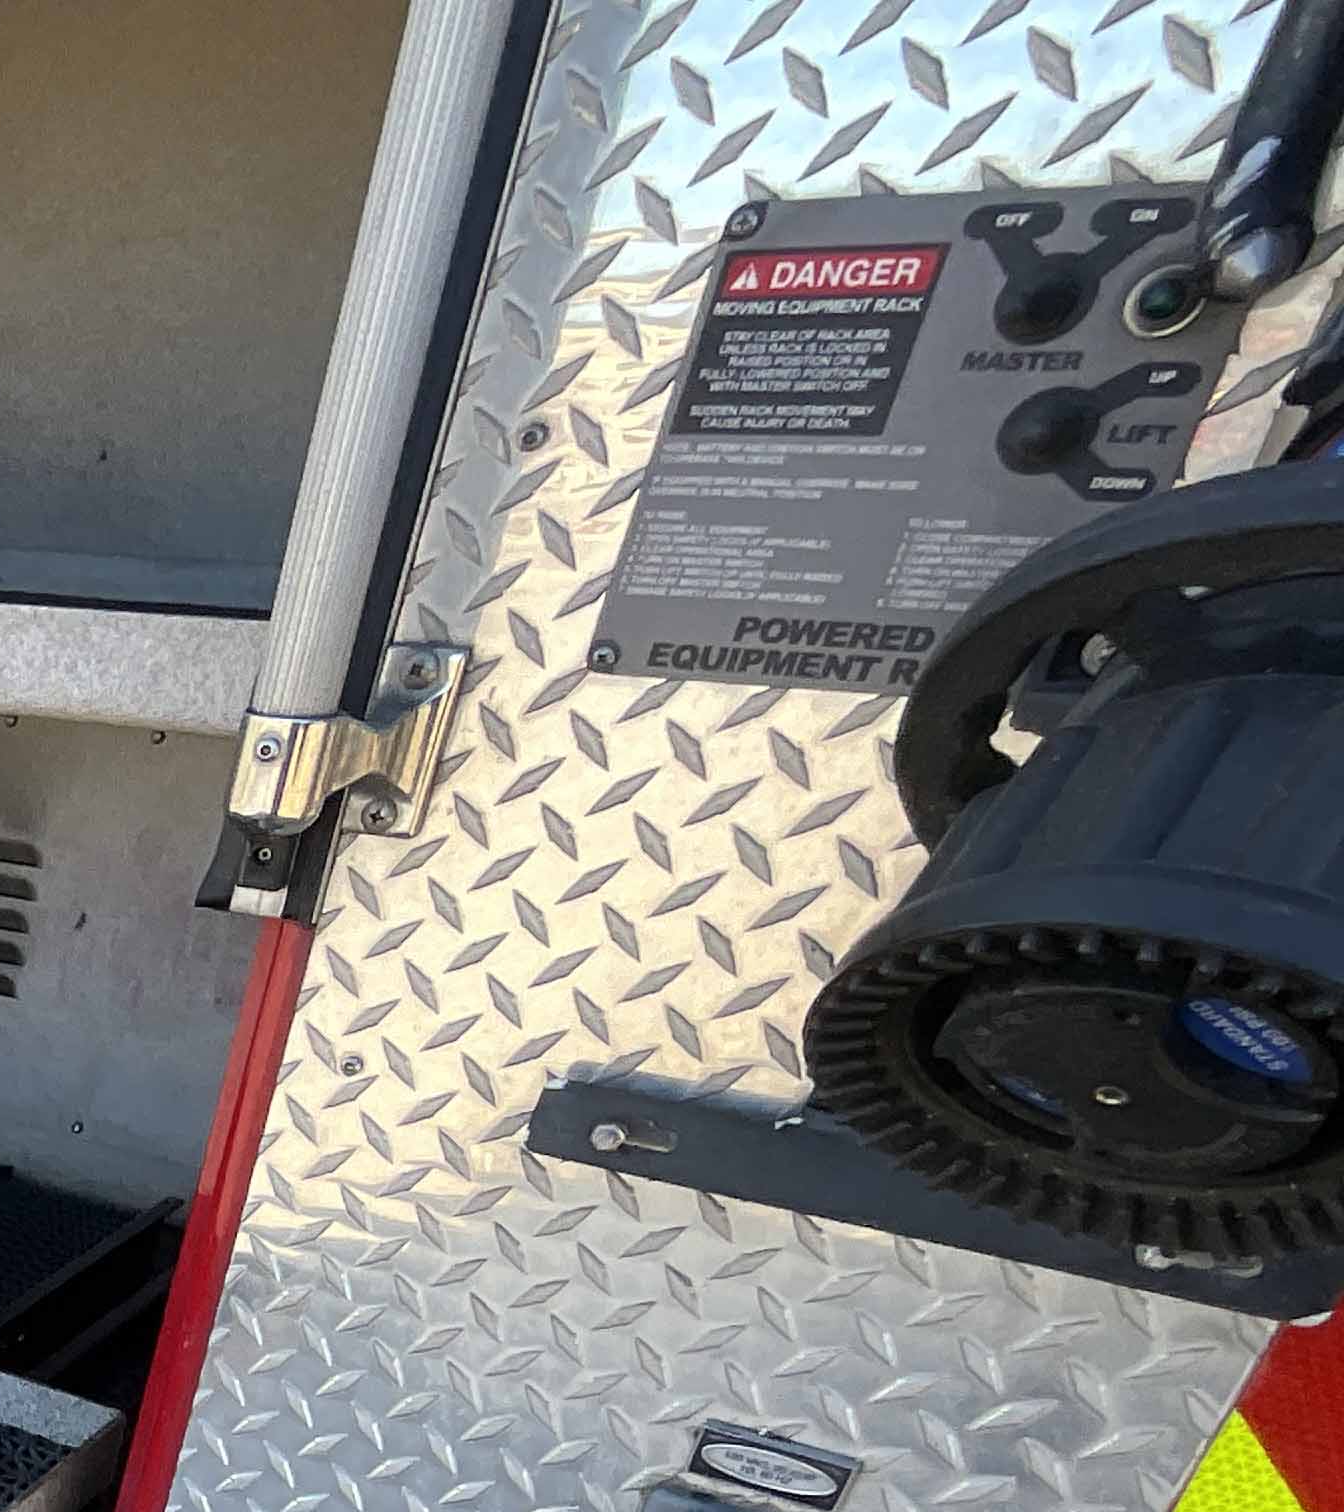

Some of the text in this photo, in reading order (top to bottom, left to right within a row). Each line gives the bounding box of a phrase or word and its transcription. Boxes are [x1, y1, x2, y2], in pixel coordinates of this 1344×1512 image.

[994, 211, 1032, 228] OFF
[1128, 208, 1160, 222] ON
[768, 257, 923, 290] DANGER
[712, 296, 924, 317] MOVING EQUIPMENT RACK
[959, 350, 1084, 372] MASTER
[1148, 369, 1178, 385] UP
[1106, 424, 1178, 444] LIFT
[1088, 476, 1147, 491] DOWN
[732, 616, 936, 653] POWERED
[647, 643, 883, 682] EQUIPMENT
